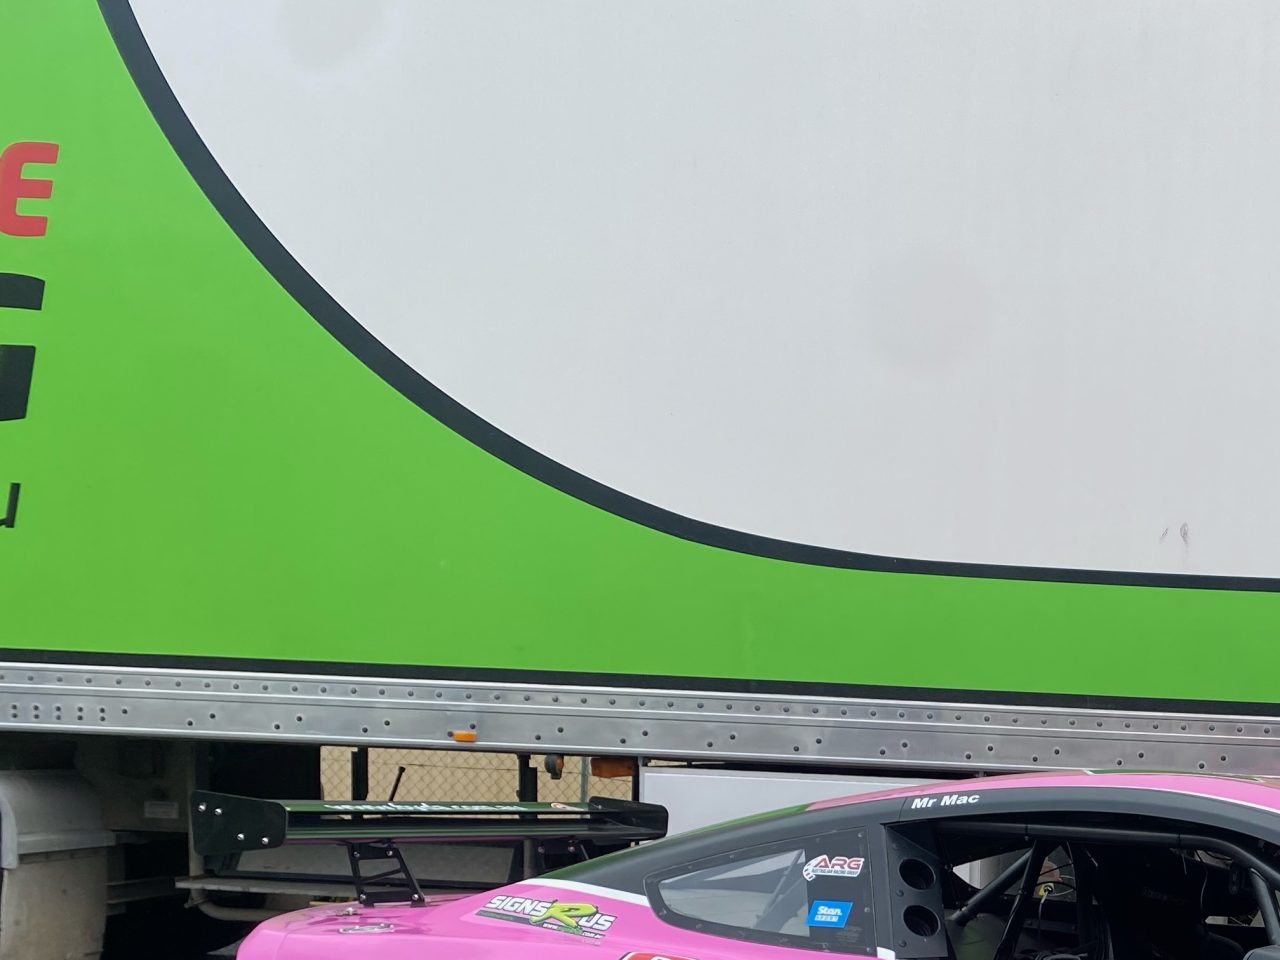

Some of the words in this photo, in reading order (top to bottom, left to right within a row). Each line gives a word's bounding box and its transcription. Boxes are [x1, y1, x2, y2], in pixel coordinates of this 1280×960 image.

[911, 797, 937, 809] Mr
[940, 794, 980, 806] Mac
[814, 857, 862, 870] ARG
[485, 895, 551, 917] SIGNS
[578, 913, 618, 931] US
